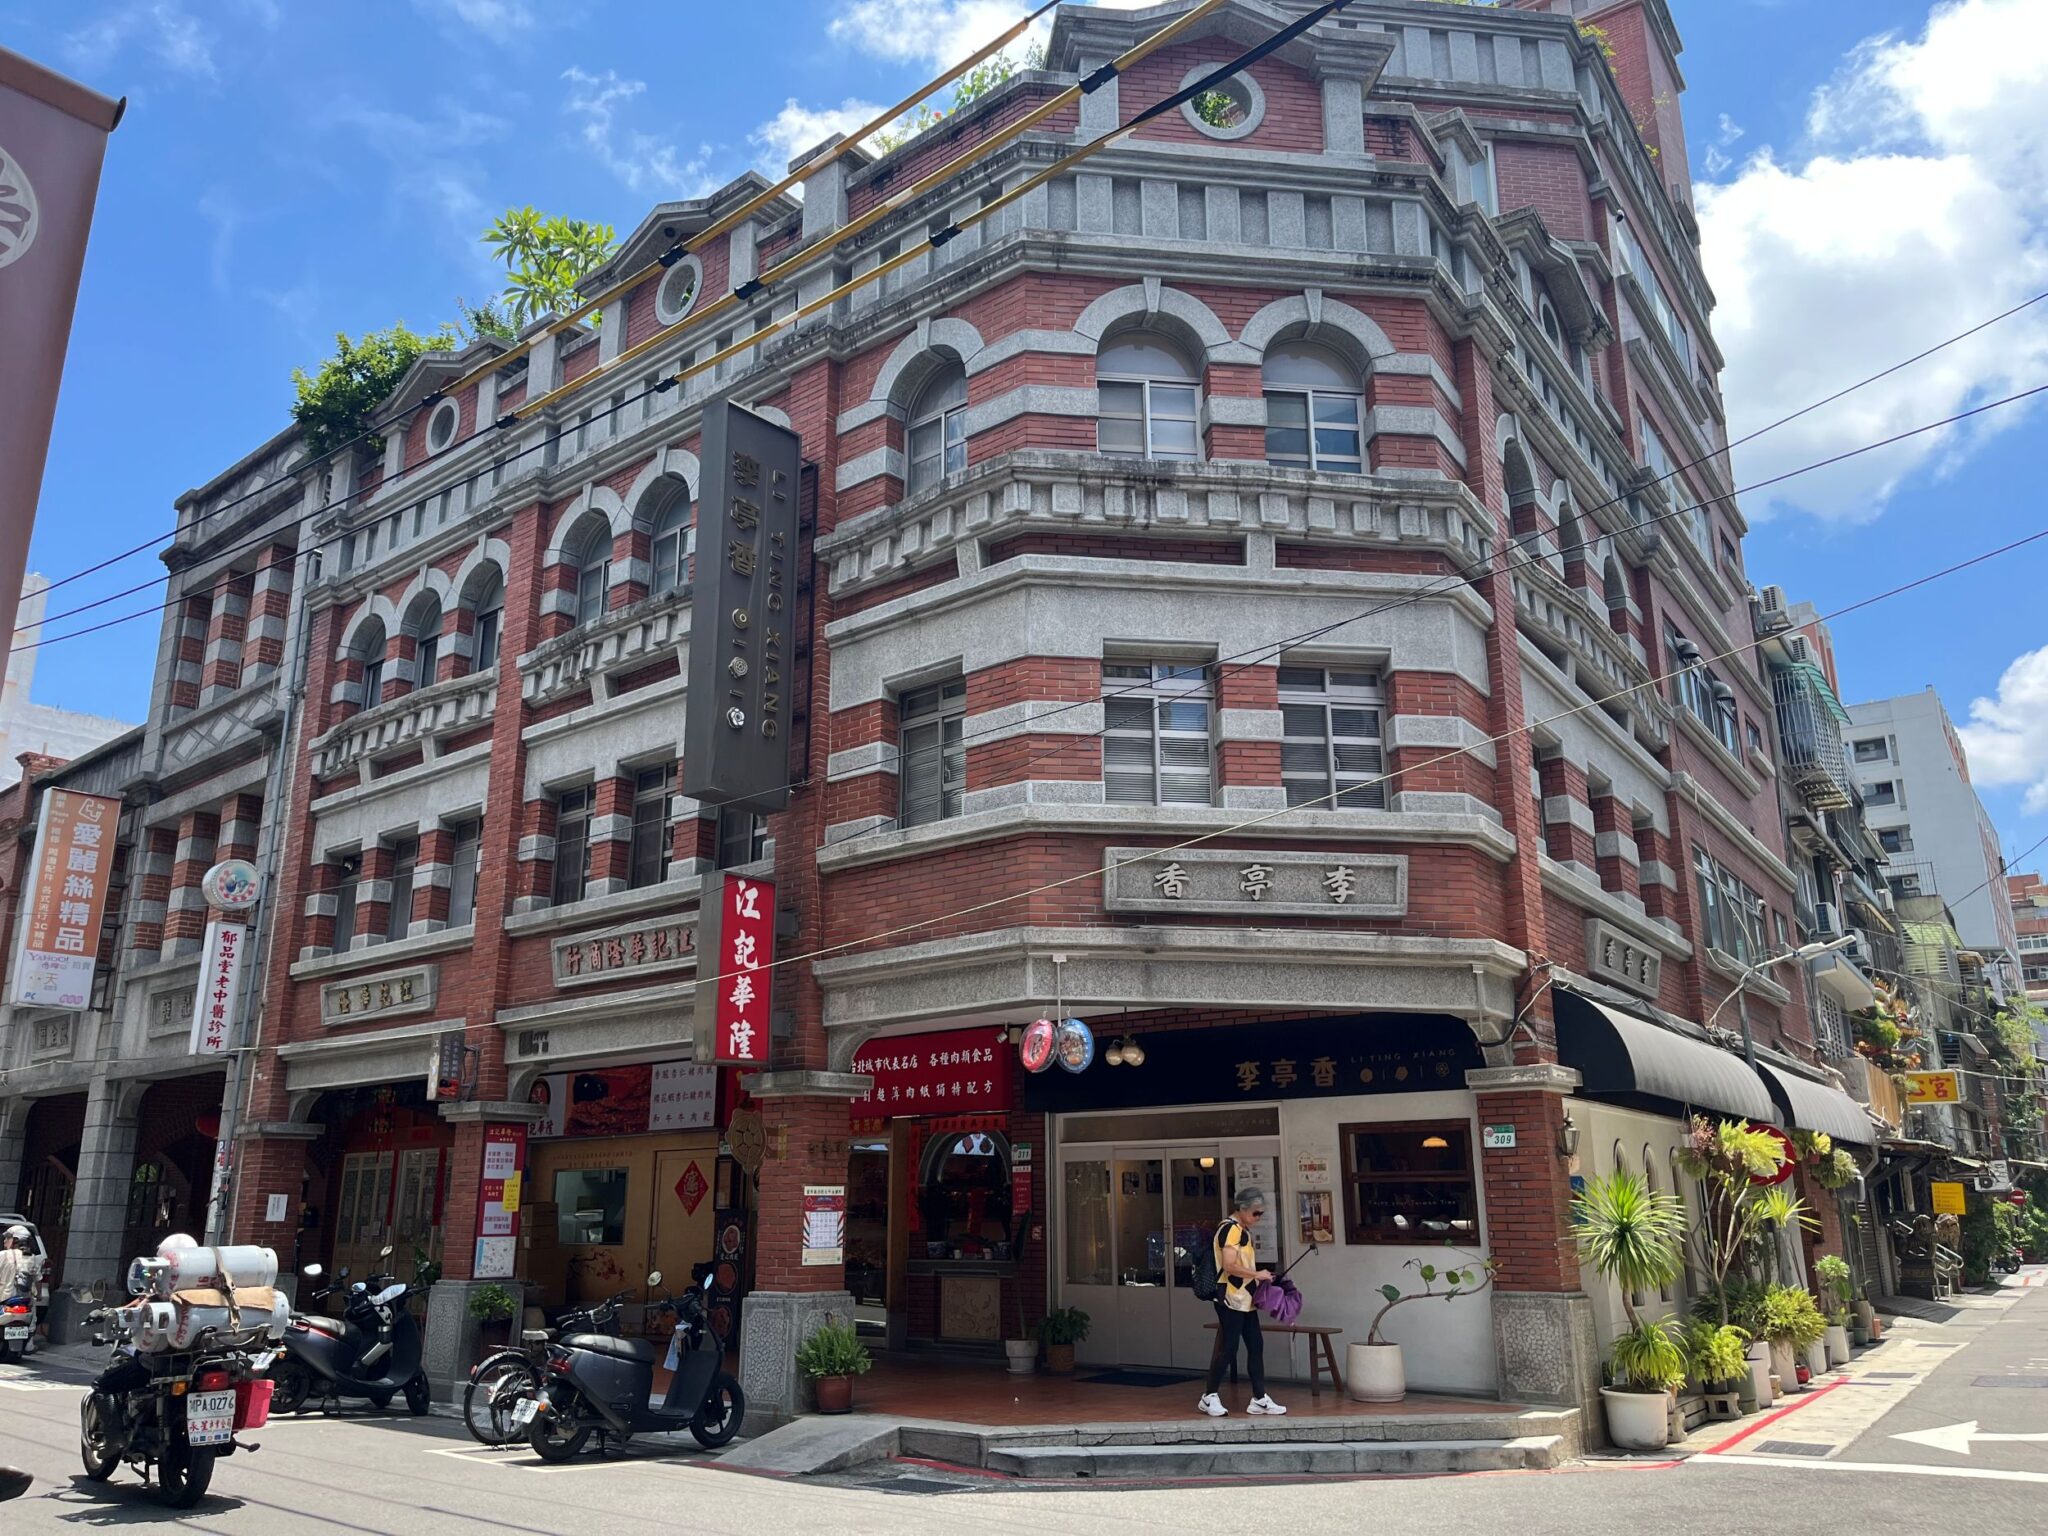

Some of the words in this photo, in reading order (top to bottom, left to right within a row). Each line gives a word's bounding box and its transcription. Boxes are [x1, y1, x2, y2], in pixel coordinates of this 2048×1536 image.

[728, 450, 761, 578] 李亭香
[766, 530, 785, 612] TING
[762, 627, 783, 743] XIANG
[54, 822, 103, 953] 愛麗絲精品
[206, 929, 238, 1048] 郁品堂老中醫診所
[728, 880, 761, 1059] 江記華隆
[929, 1048, 993, 1067] 各種肉類食品
[1235, 1056, 1337, 1091] 李亭香
[1413, 1048, 1456, 1059] XIANG
[1494, 1135, 1512, 1144] 309
